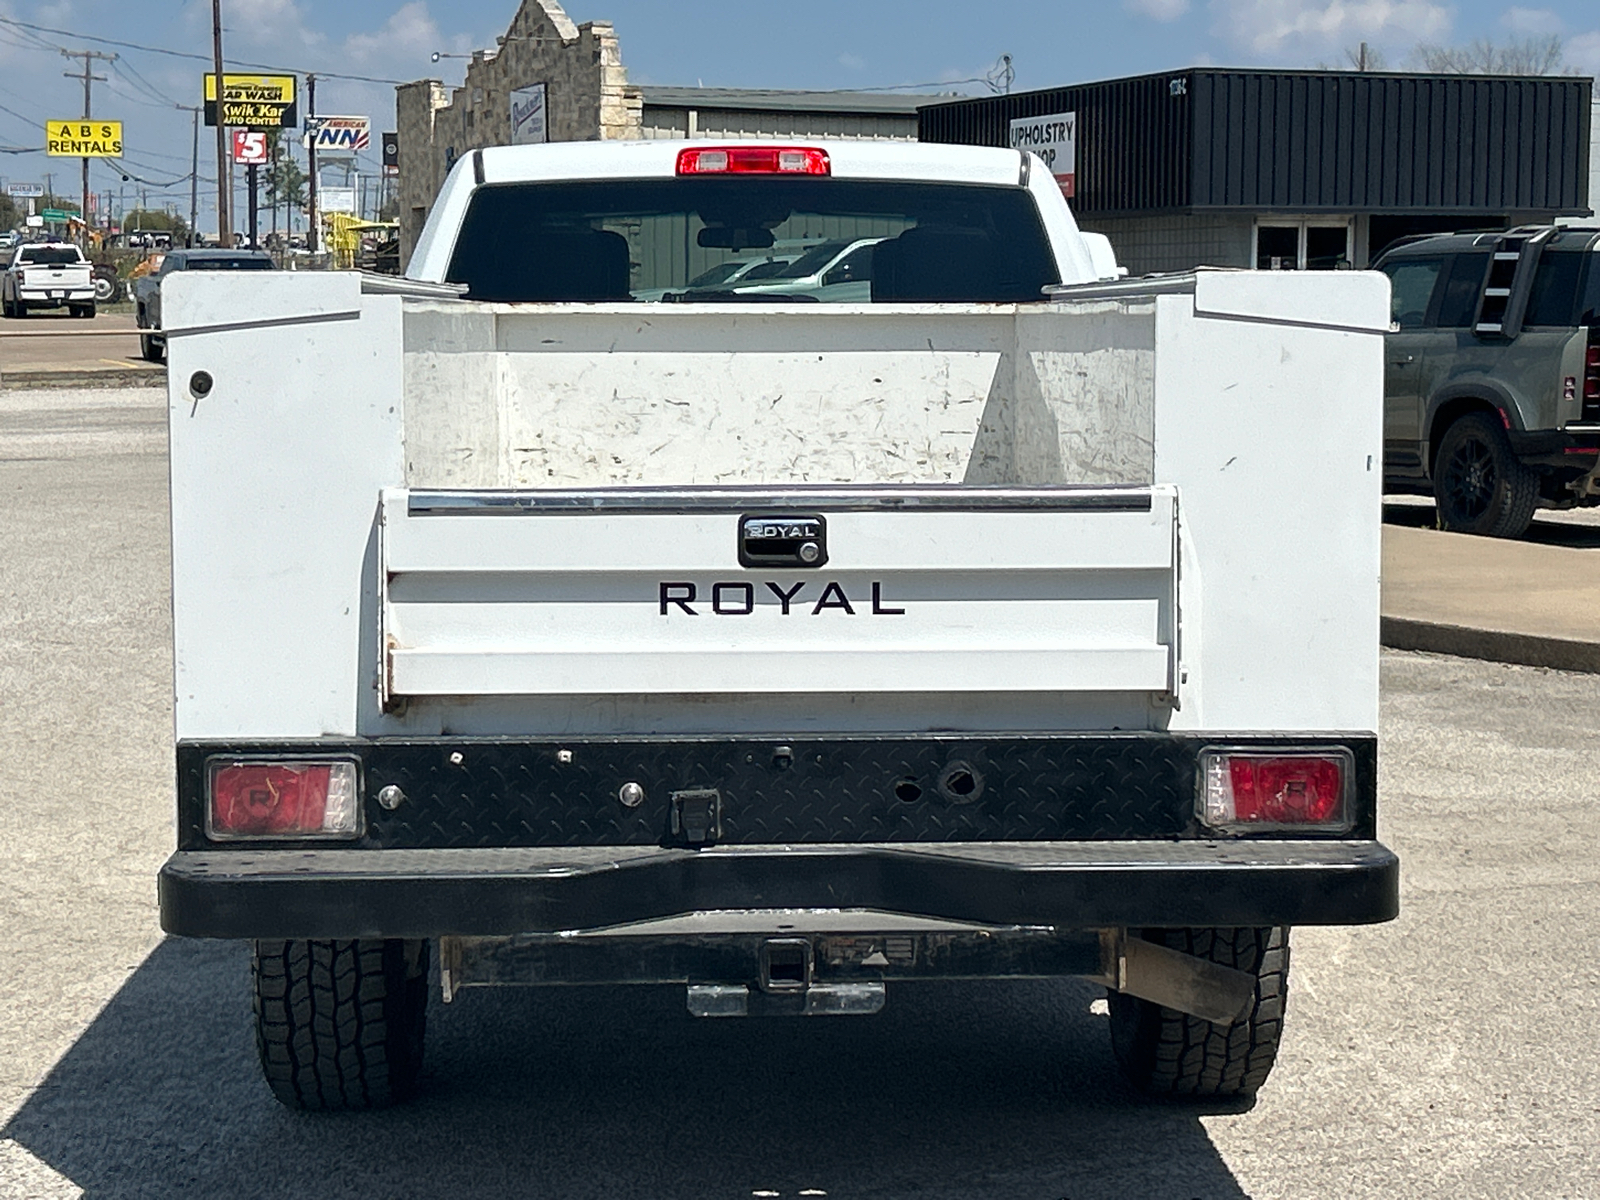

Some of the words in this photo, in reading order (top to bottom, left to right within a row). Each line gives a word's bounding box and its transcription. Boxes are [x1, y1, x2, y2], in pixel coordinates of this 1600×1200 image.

[222, 90, 242, 99] AR
[245, 90, 282, 100] WASH
[257, 104, 285, 117] Kar
[245, 117, 282, 126] CENTER
[313, 129, 361, 145] NN
[1010, 120, 1074, 148] UPHOLSTRY
[48, 140, 122, 153] RENTALS
[1033, 149, 1056, 169] OP
[749, 525, 816, 538] ROYAL
[659, 581, 906, 616] ROYAL
